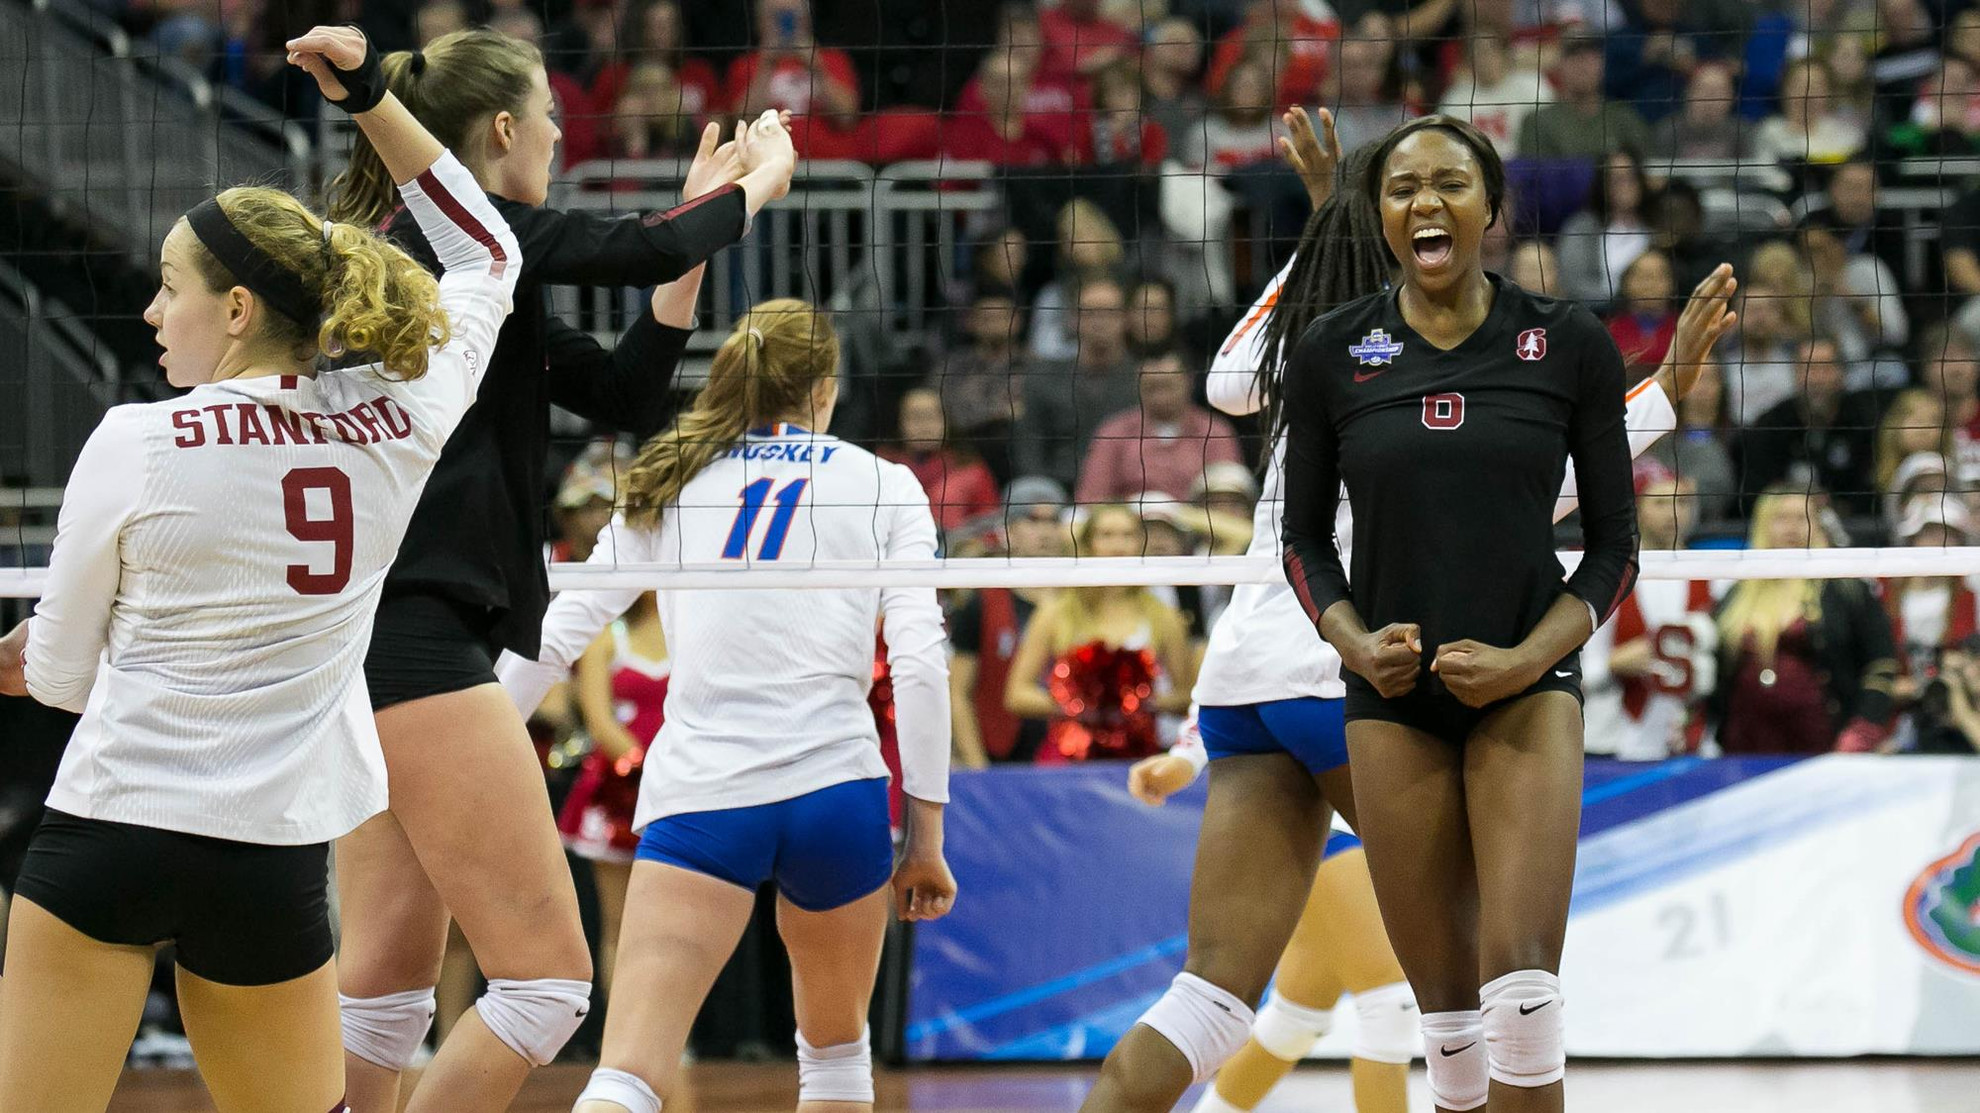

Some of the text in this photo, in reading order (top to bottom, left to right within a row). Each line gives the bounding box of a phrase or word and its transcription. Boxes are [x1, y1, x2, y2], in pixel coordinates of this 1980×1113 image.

[171, 395, 412, 448] STANFORD
[1422, 392, 1465, 431] 0
[281, 466, 354, 595] 9
[720, 477, 809, 561] 11
[1652, 624, 1696, 698] S
[1654, 891, 1732, 962] 21
